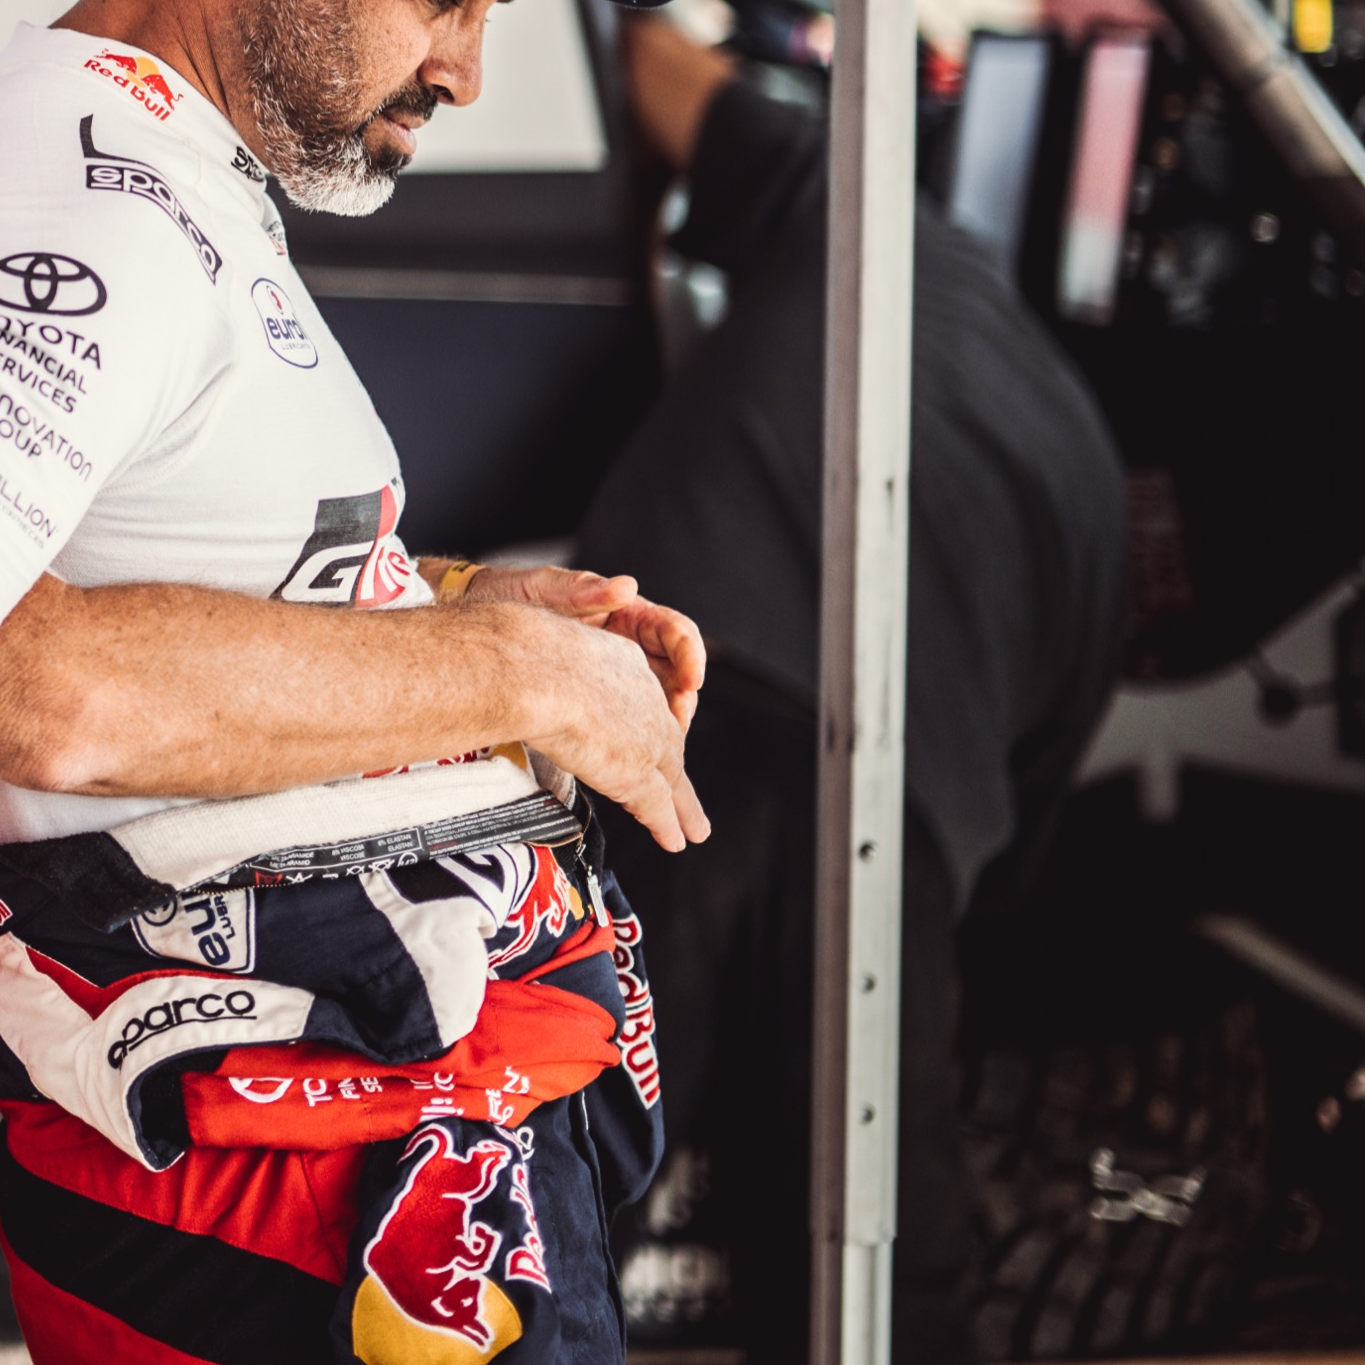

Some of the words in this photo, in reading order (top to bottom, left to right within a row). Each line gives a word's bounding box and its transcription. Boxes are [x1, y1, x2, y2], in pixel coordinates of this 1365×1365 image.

[83, 58, 130, 88] Red
[129, 86, 172, 122] Bull
[87, 164, 223, 275] sparco
[617, 997, 662, 1111] Bull
